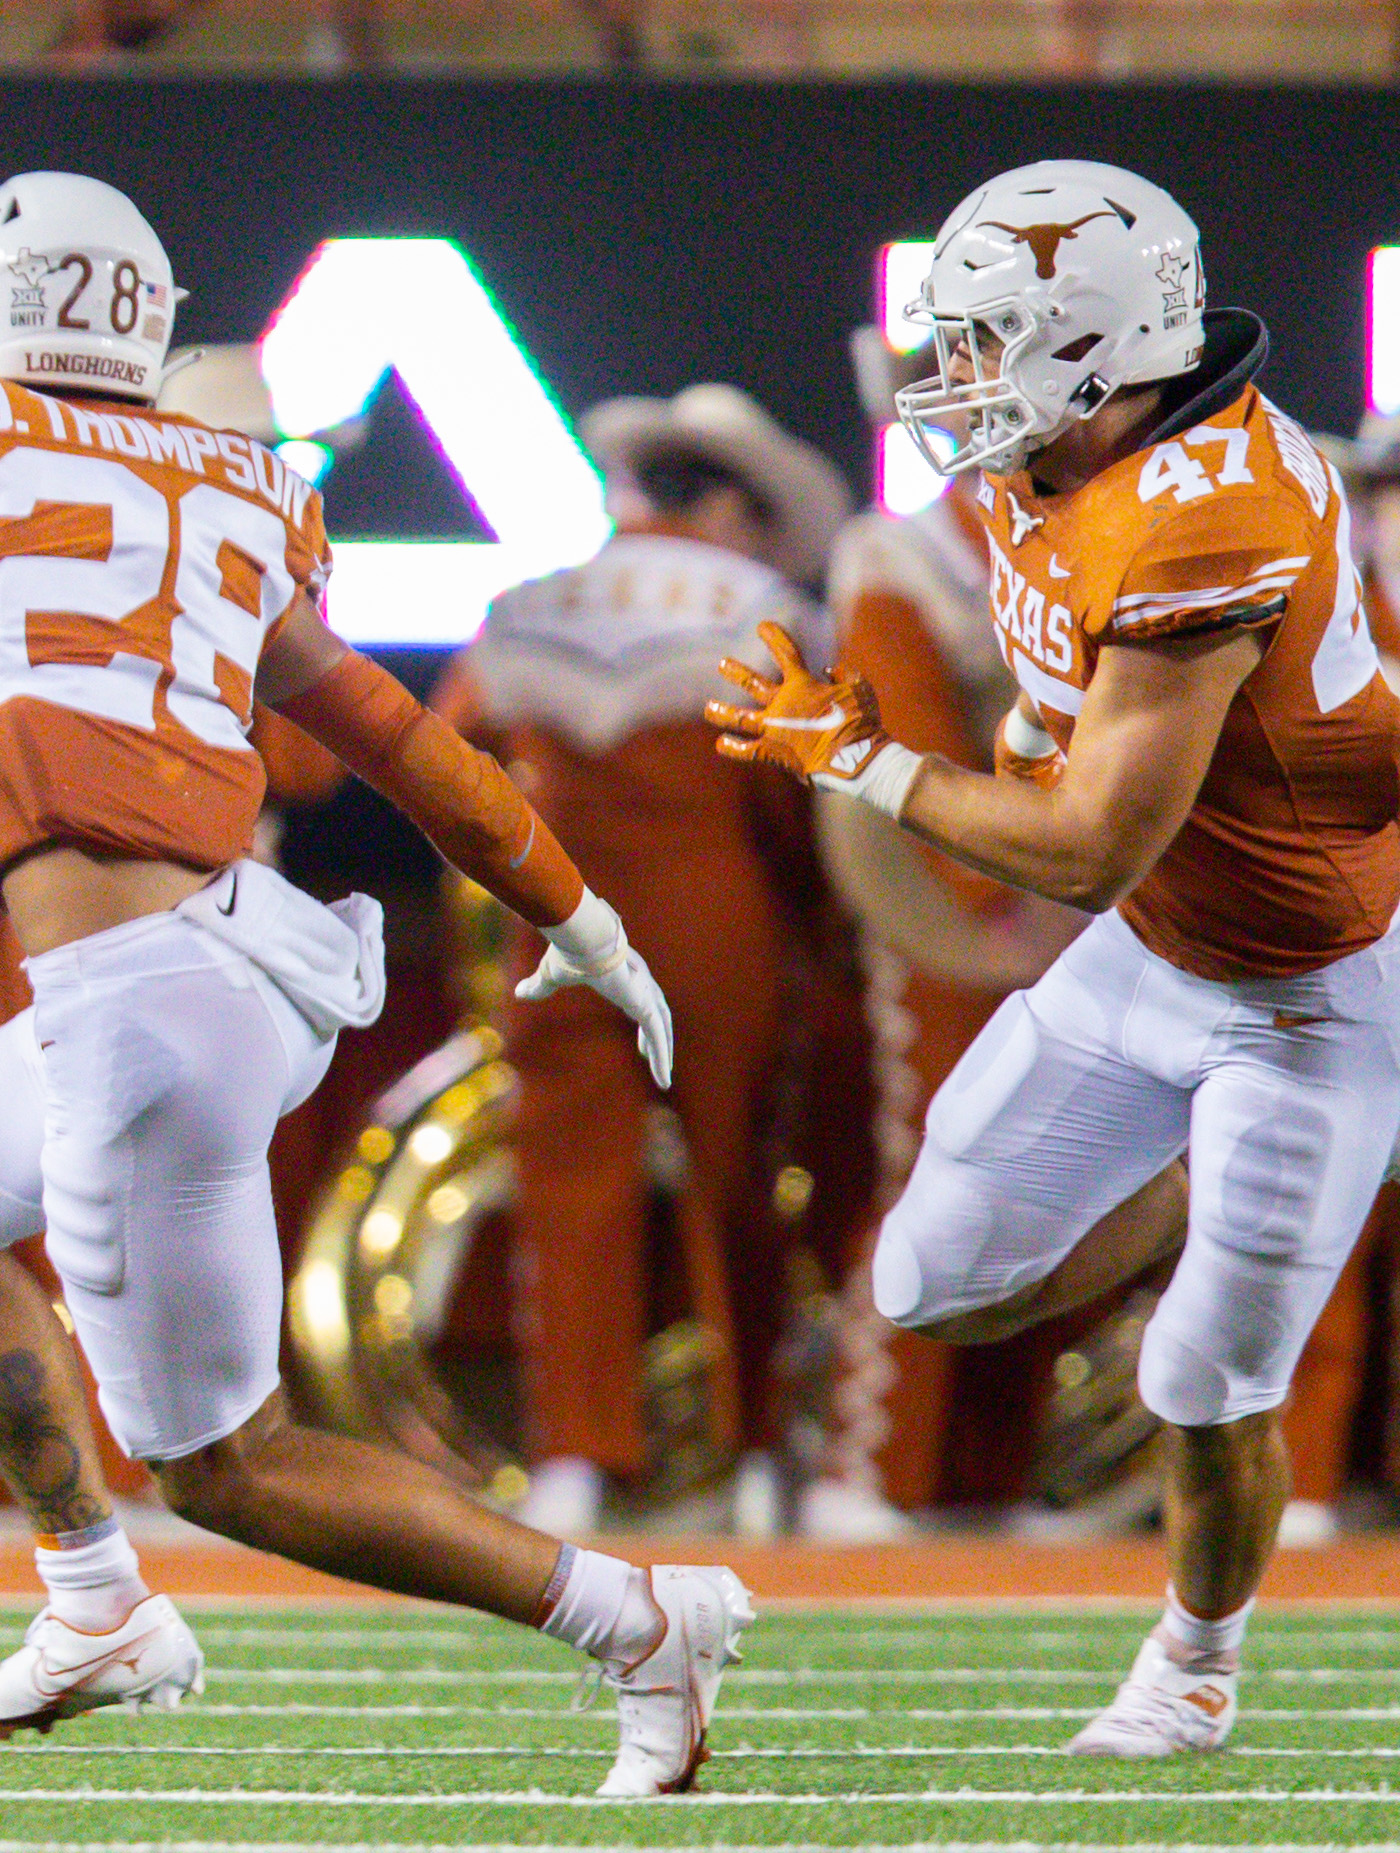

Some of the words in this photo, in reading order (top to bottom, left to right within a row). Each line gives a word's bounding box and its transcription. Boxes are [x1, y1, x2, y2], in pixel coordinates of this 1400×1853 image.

[10, 310, 46, 327] UNITY
[57, 252, 141, 335] 28
[24, 352, 147, 386] LONGHORNS
[27, 388, 312, 529] THOMPSON
[1137, 425, 1255, 503] 47
